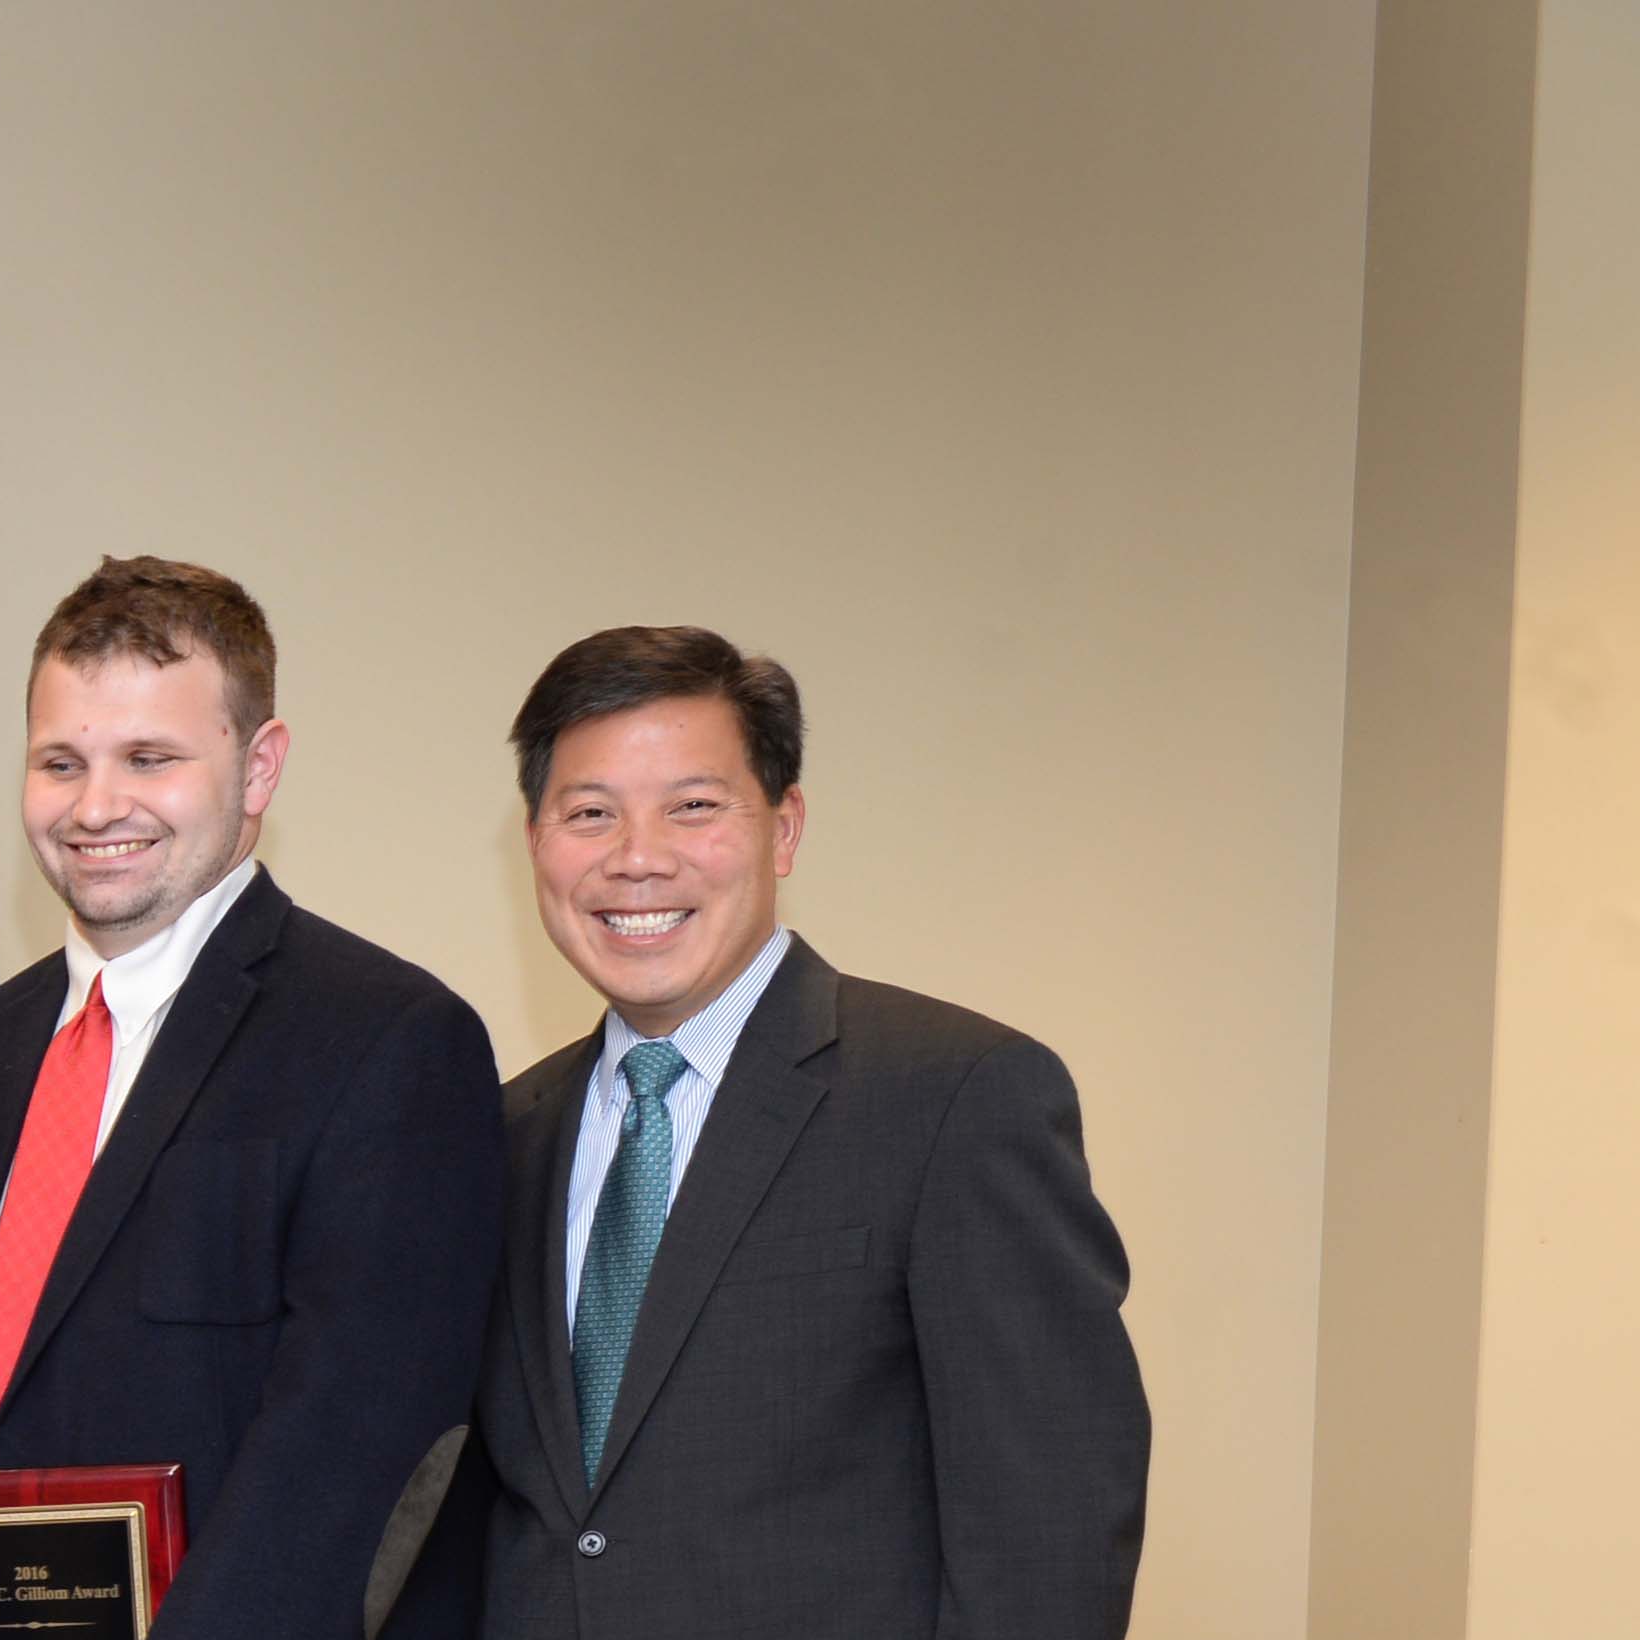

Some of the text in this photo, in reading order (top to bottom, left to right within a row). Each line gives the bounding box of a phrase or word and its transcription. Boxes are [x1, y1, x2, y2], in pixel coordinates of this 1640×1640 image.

[14, 1566, 49, 1581] 2016
[15, 1585, 69, 1601] Gilliom
[72, 1583, 120, 1599] Award
